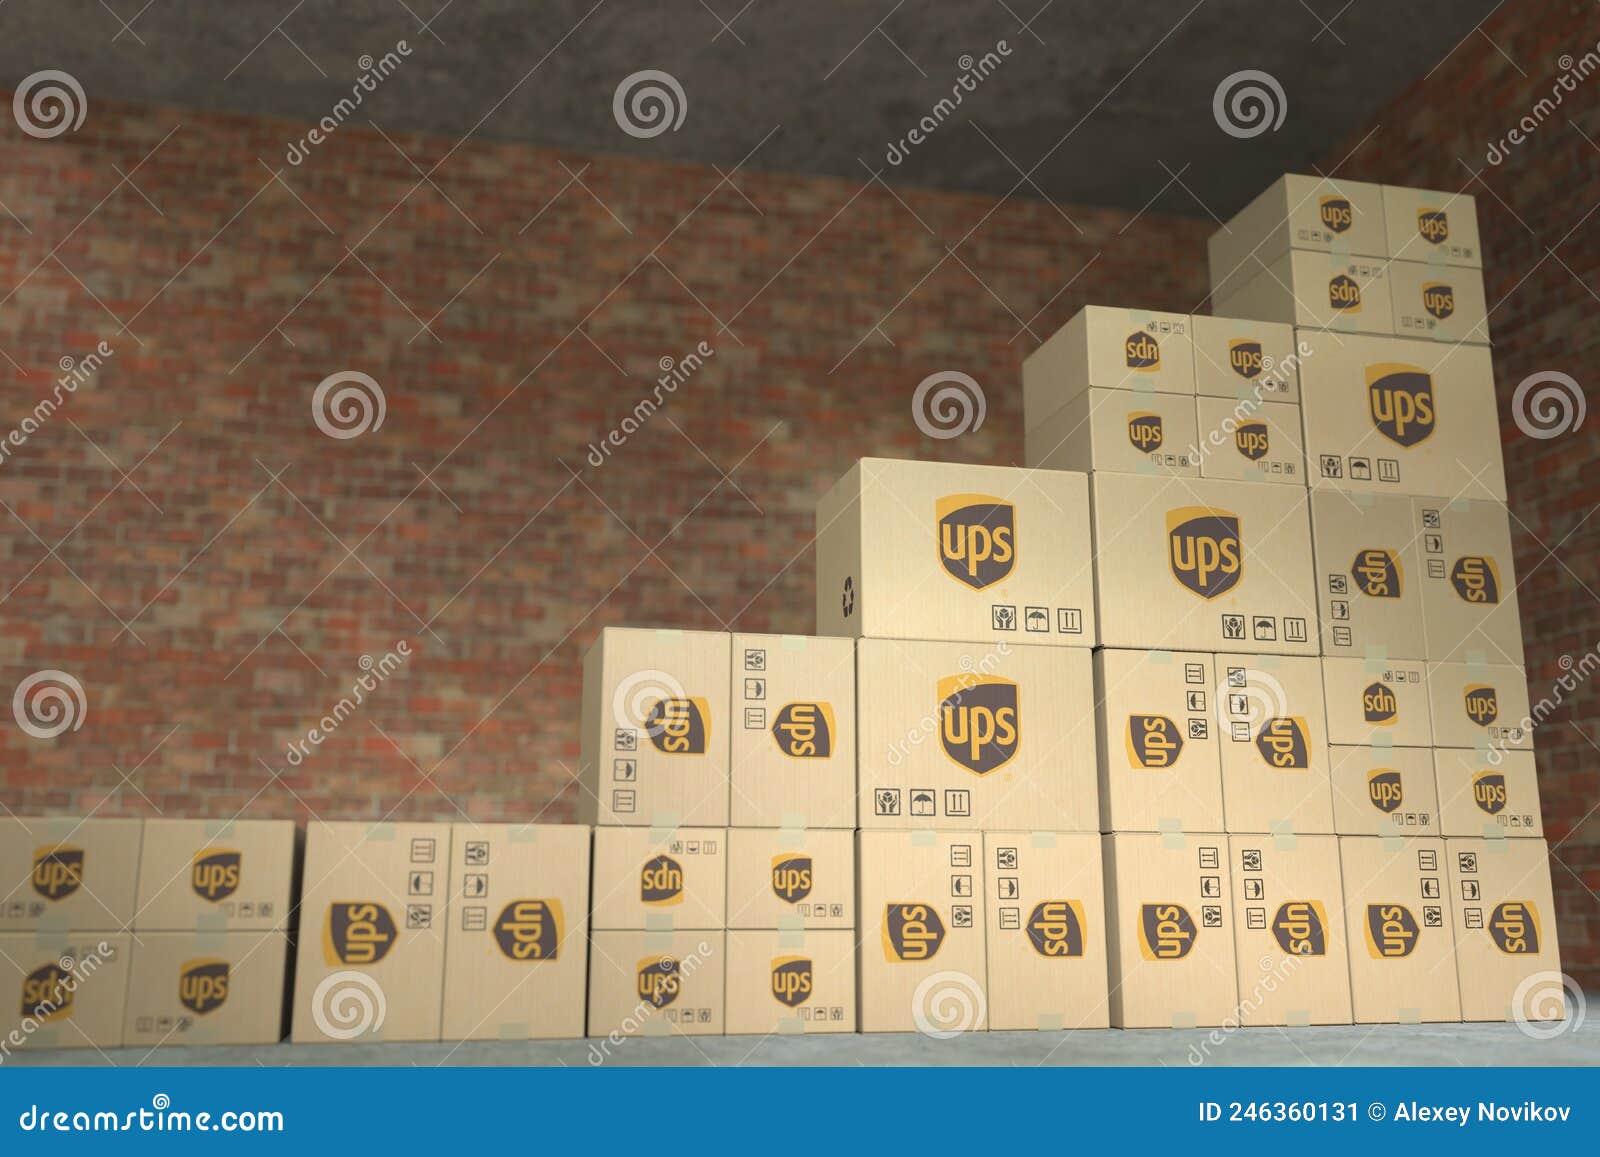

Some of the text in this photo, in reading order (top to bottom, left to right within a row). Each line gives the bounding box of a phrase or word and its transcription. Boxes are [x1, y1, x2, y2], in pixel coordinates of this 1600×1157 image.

[1322, 206, 1351, 229] ups
[1419, 218, 1447, 240] ups
[1330, 280, 1359, 302] ups
[1424, 292, 1454, 315] ups
[1127, 336, 1158, 361] ups
[1231, 350, 1262, 373] ups
[1372, 389, 1433, 436] ups
[1130, 424, 1162, 448] ups
[1237, 432, 1268, 455] ups
[942, 522, 1012, 577] ups
[1172, 534, 1238, 586] ups
[1358, 552, 1388, 596] ups
[1456, 558, 1487, 601] ups
[1364, 687, 1395, 713] ups
[1467, 697, 1496, 721] ups
[654, 699, 690, 751] ups
[781, 705, 816, 755] ups
[943, 705, 1016, 760] ups
[1144, 717, 1176, 765] ups
[1263, 718, 1295, 766] ups
[1370, 782, 1399, 807] ups
[1475, 784, 1505, 809] ups
[35, 861, 81, 895] ups
[194, 863, 239, 896] ups
[642, 861, 681, 891] ups
[774, 869, 810, 897] ups
[346, 904, 387, 963] ups
[502, 902, 542, 958] ups
[902, 905, 937, 960] ups
[1033, 903, 1067, 955] ups
[1157, 906, 1190, 956] ups
[1279, 904, 1311, 954] ups
[1384, 906, 1412, 955] ups
[1495, 904, 1527, 952] ups
[182, 974, 226, 1008] ups
[773, 971, 810, 1001] ups
